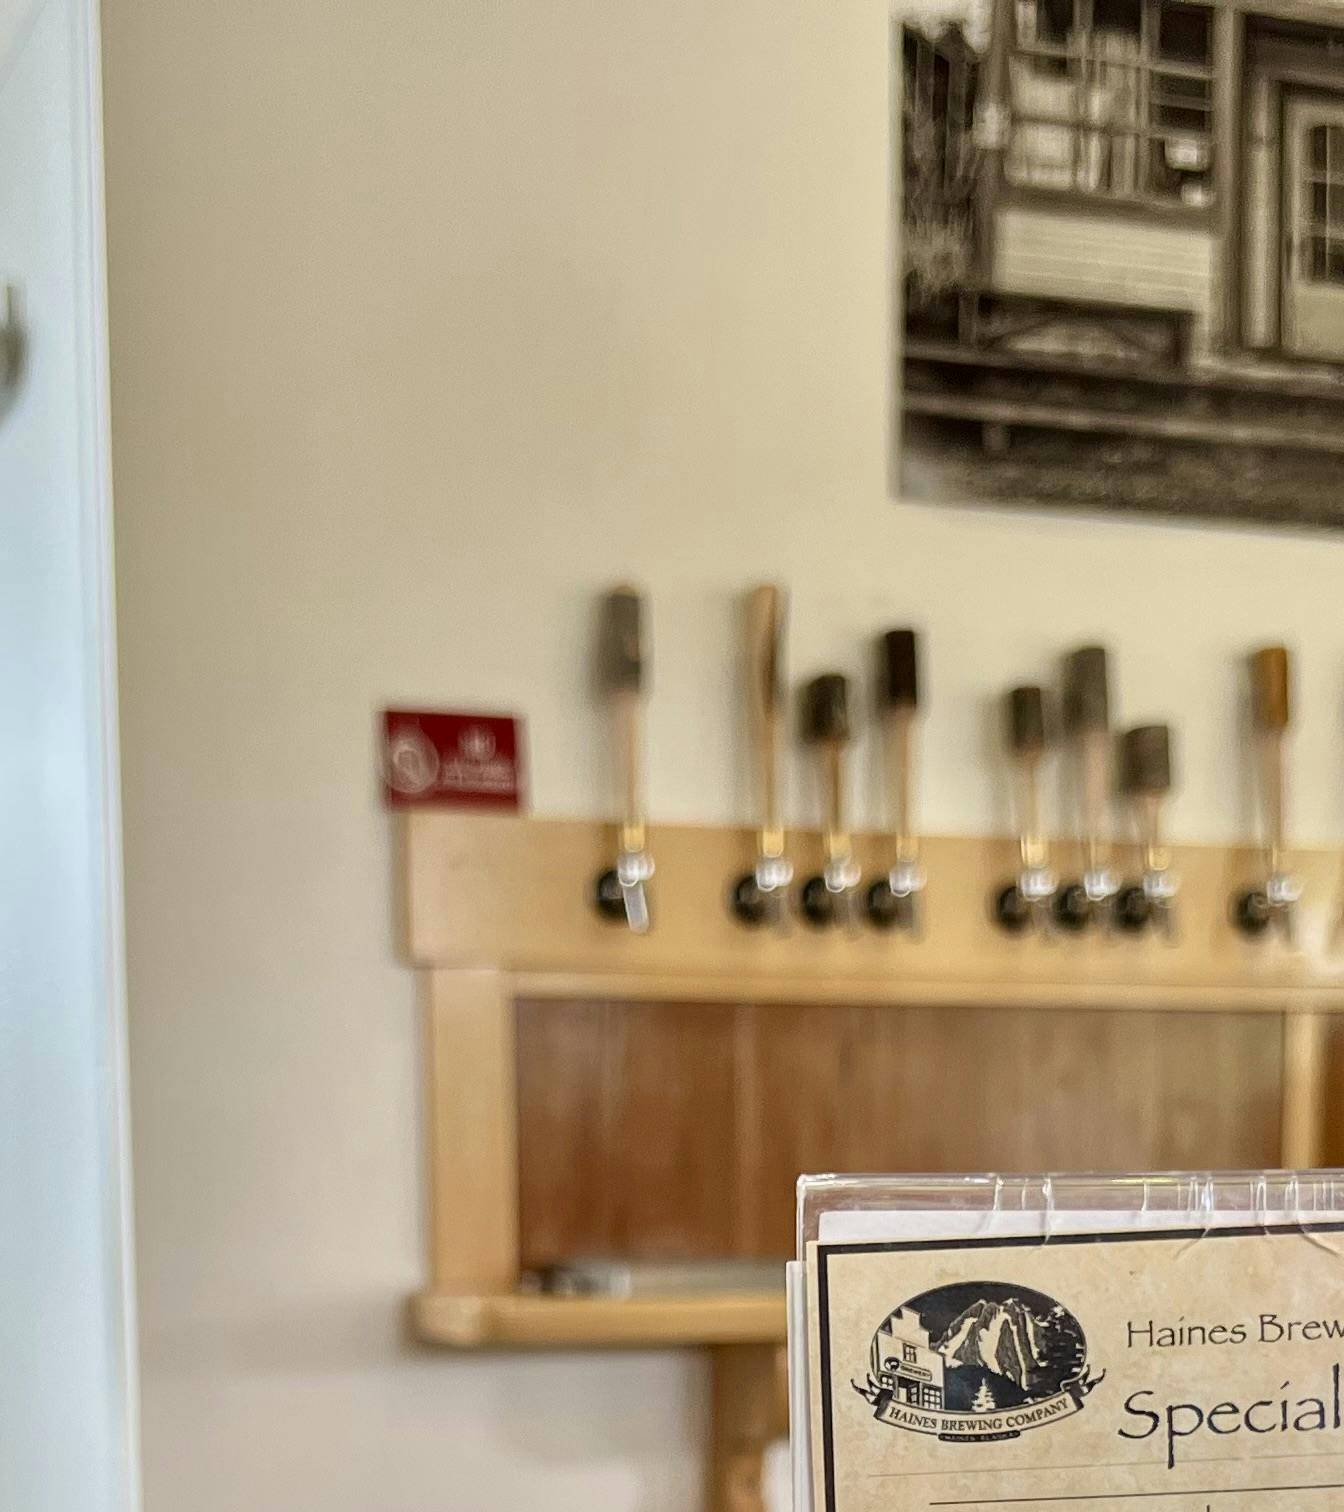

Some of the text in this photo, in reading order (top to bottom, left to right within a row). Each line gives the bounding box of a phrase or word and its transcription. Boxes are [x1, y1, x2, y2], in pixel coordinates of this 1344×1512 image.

[1126, 1315, 1248, 1349] Haines
[889, 1398, 1069, 1433] HAINES BREWING COMPANY
